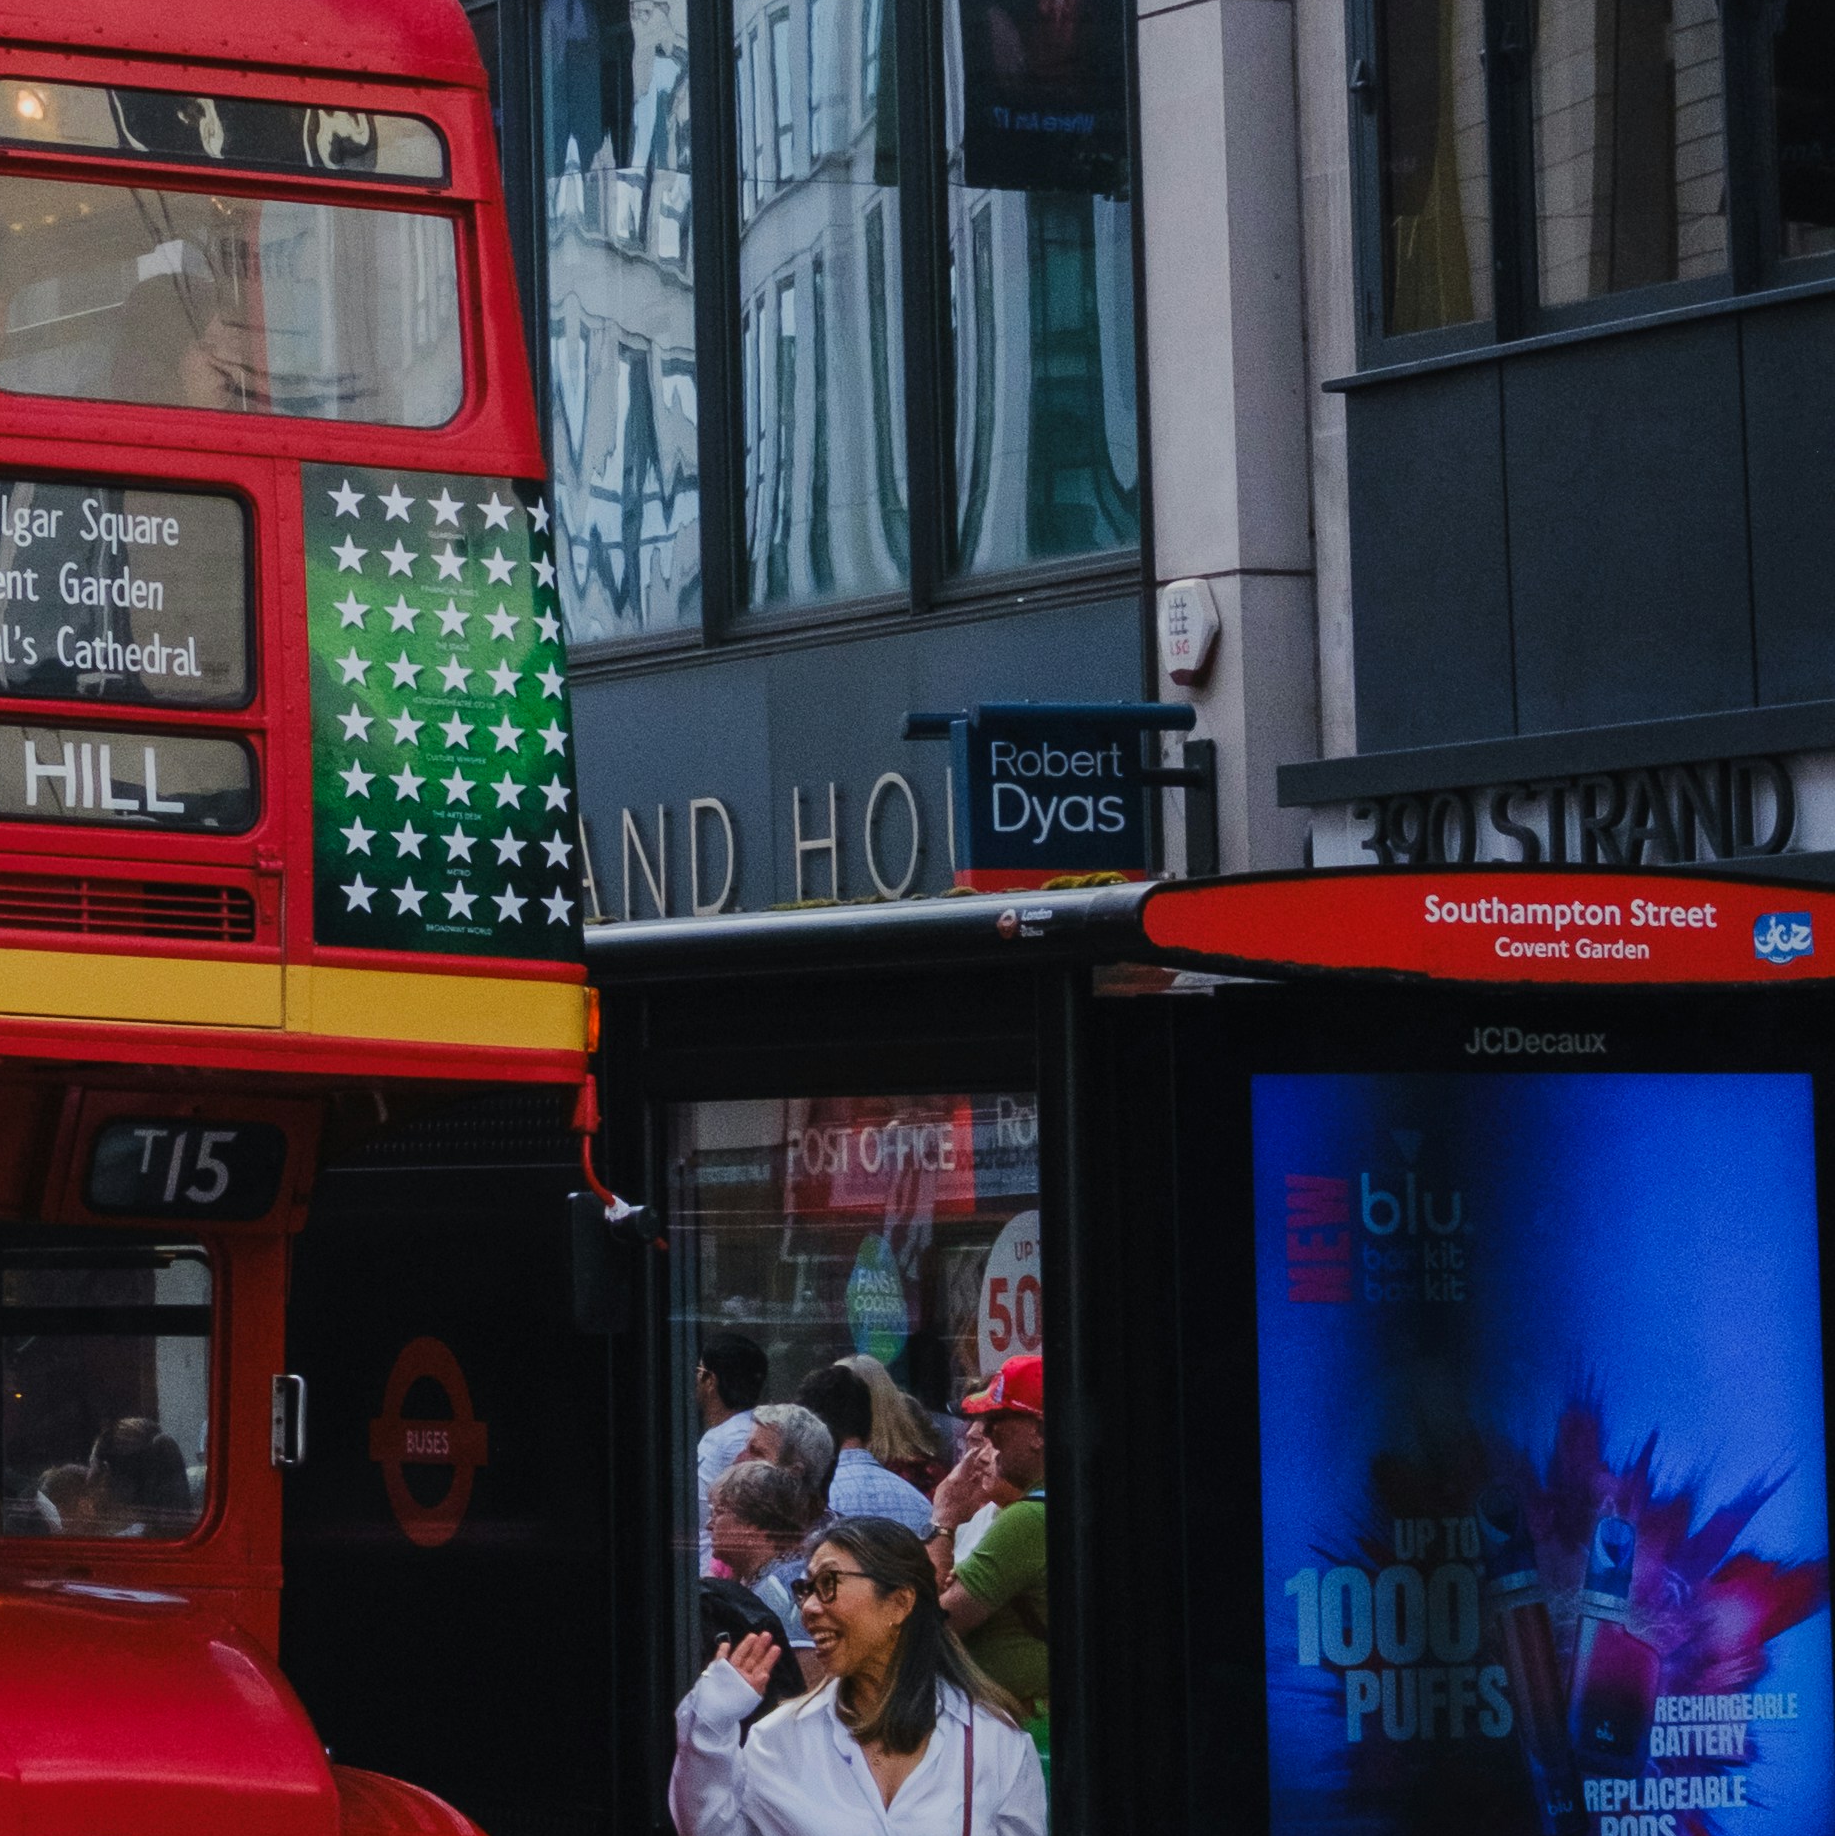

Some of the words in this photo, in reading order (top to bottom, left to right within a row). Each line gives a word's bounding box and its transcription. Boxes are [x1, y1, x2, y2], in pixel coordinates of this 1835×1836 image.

[79, 499, 180, 555] Square
[59, 562, 165, 611] Garden
[56, 628, 202, 677] Cathedral
[25, 740, 184, 813] HILL
[991, 742, 1124, 777] Robert
[993, 782, 1126, 844] Dyas
[1351, 792, 1475, 864] 390
[1488, 762, 1798, 865] STRAND
[446, 868, 471, 877] METRO
[1424, 895, 1621, 931] Southampton
[1630, 899, 1718, 928] Street
[1495, 936, 1569, 958] Covent
[1575, 939, 1650, 960] Garden
[1466, 1027, 1606, 1053] JCDecaux
[788, 1127, 853, 1176] POST
[859, 1119, 957, 1172] OFFICE
[1285, 1175, 1351, 1302] NEW
[406, 1429, 449, 1454] BUSES
[1394, 1518, 1433, 1560] UP
[1444, 1515, 1481, 1559] TO
[1346, 1666, 1513, 1742] PUFFS
[1654, 1693, 1798, 1723] RECHARGEABLE
[1650, 1724, 1747, 1757] BATTERY
[1584, 1776, 1747, 1813] REPLACEABLE
